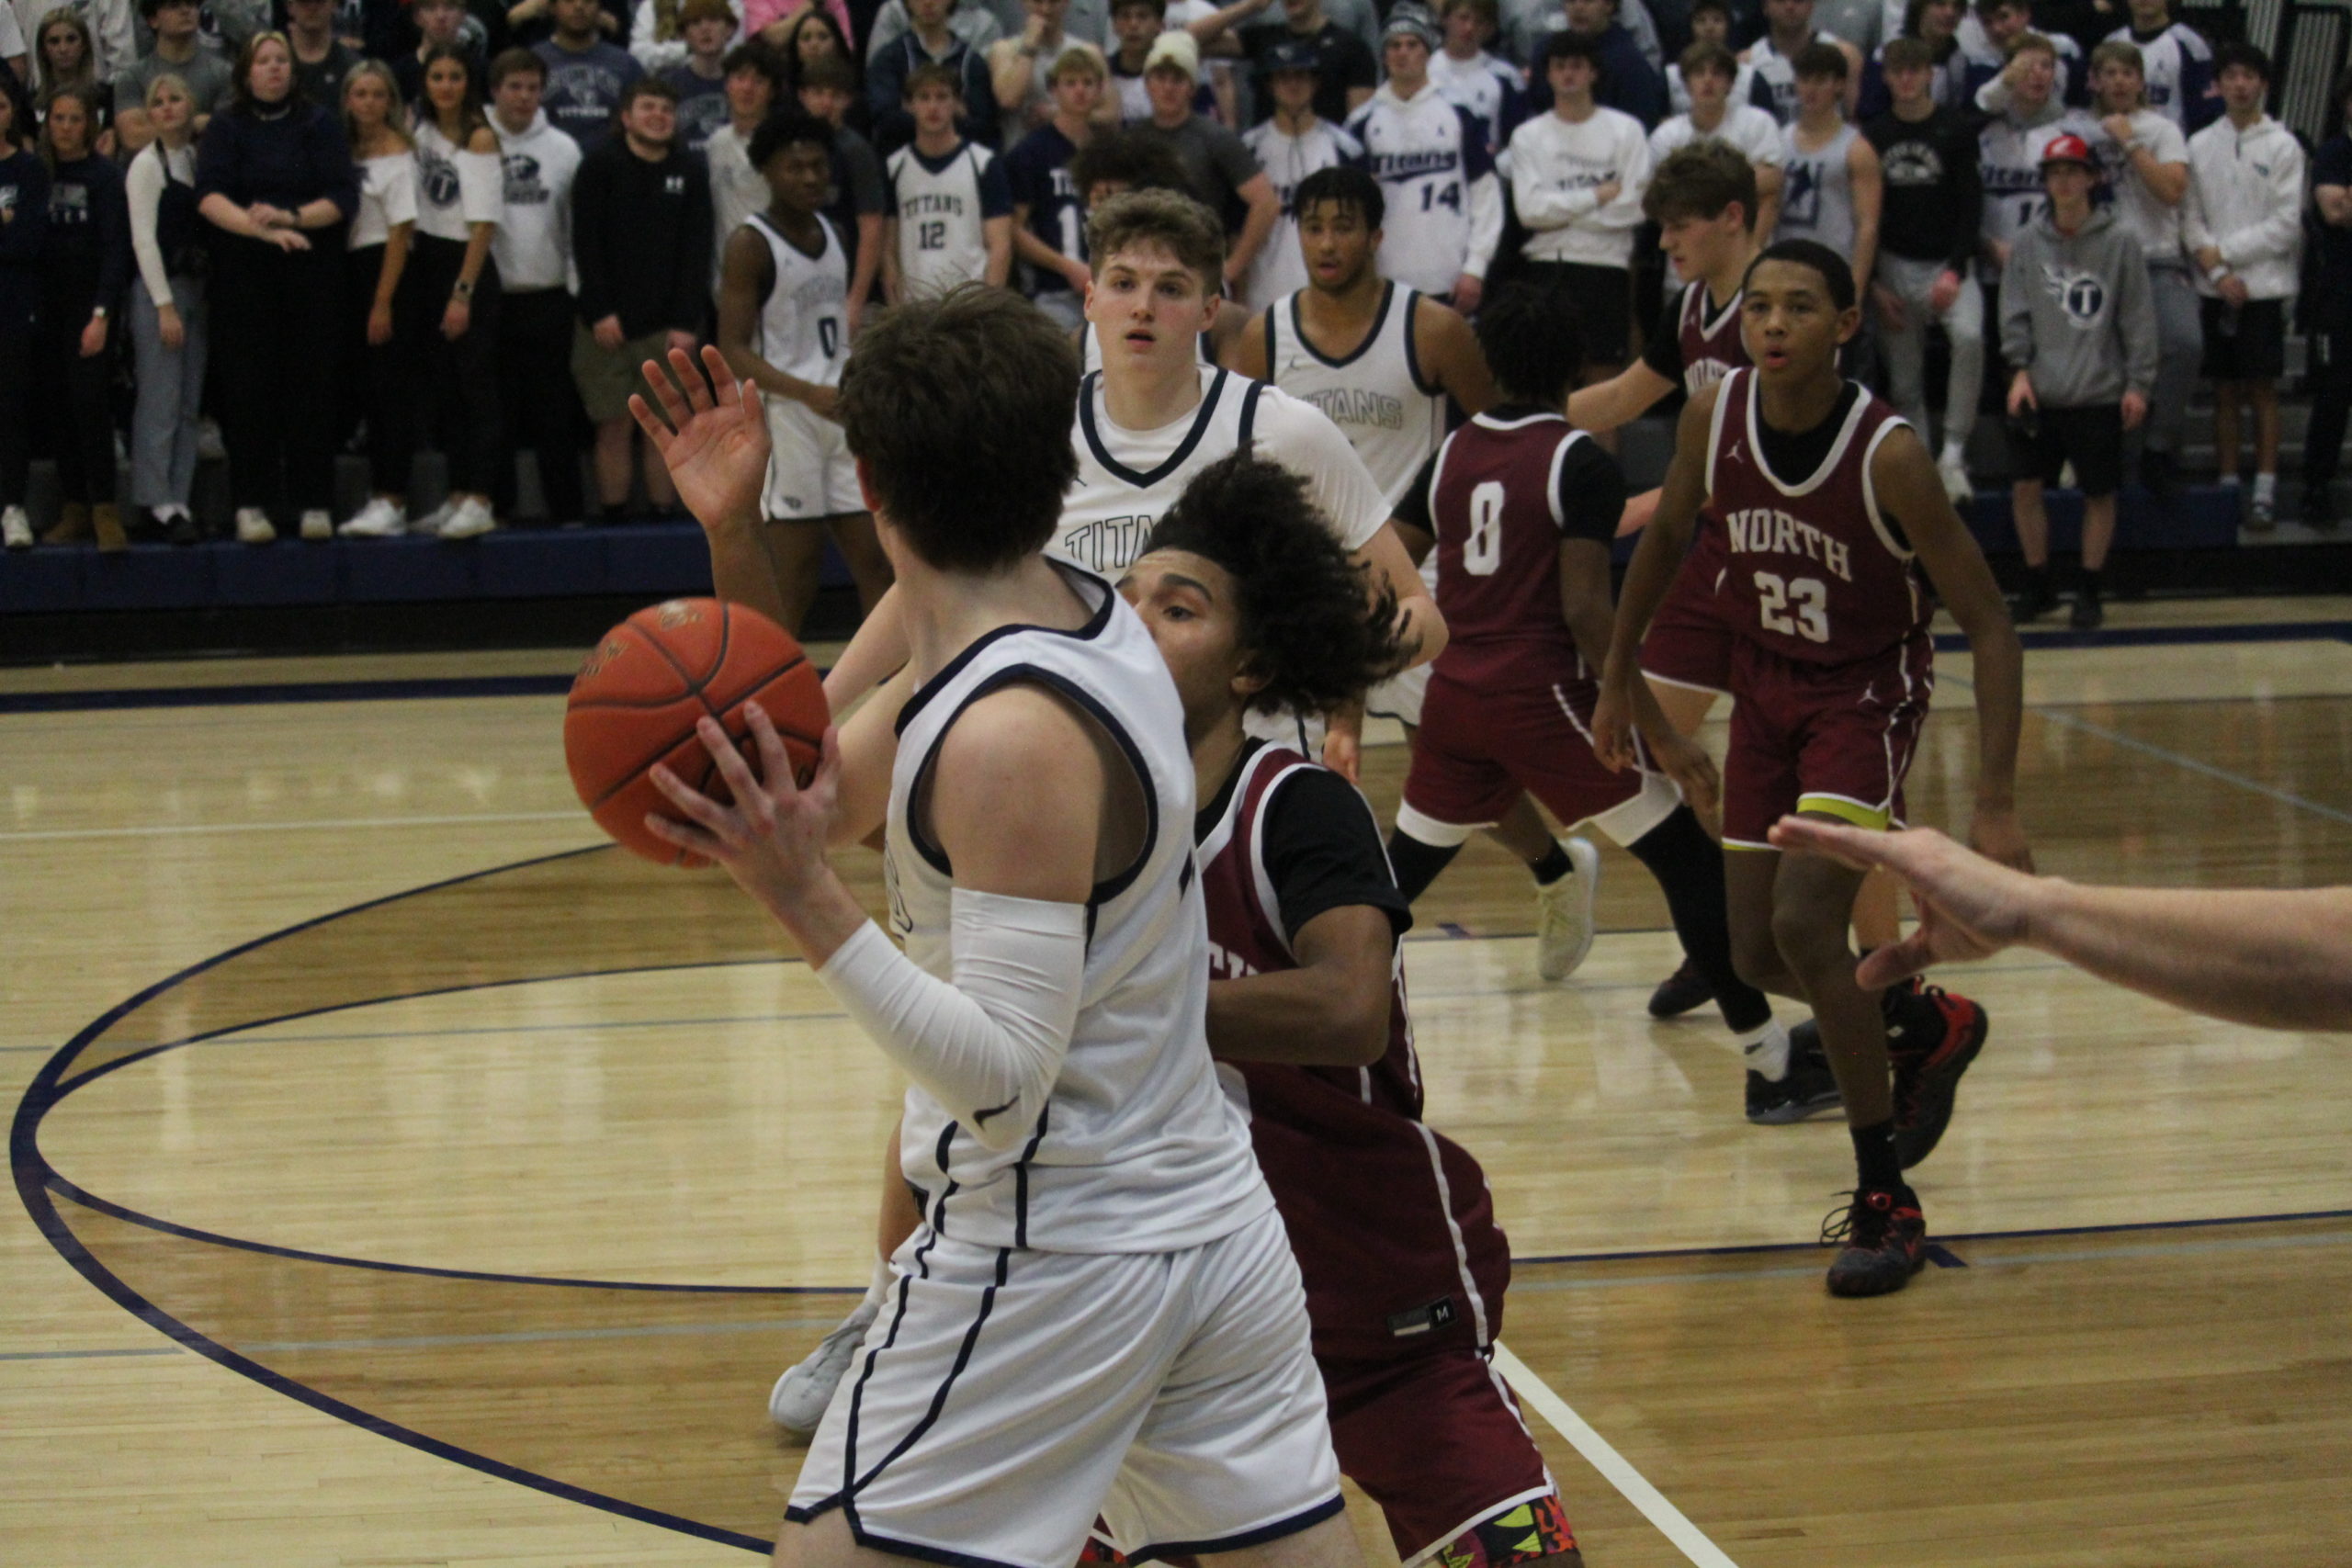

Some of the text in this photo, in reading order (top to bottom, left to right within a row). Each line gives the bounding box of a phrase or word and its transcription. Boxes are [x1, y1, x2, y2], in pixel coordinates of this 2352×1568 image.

[904, 193, 963, 219] TITANS
[1421, 181, 1463, 216] 14
[920, 221, 945, 249] 12
[1303, 388, 1403, 431] TANS
[1065, 514, 1155, 572] TITA
[1726, 508, 1852, 582] NORTH
[1754, 570, 1829, 643] 23
